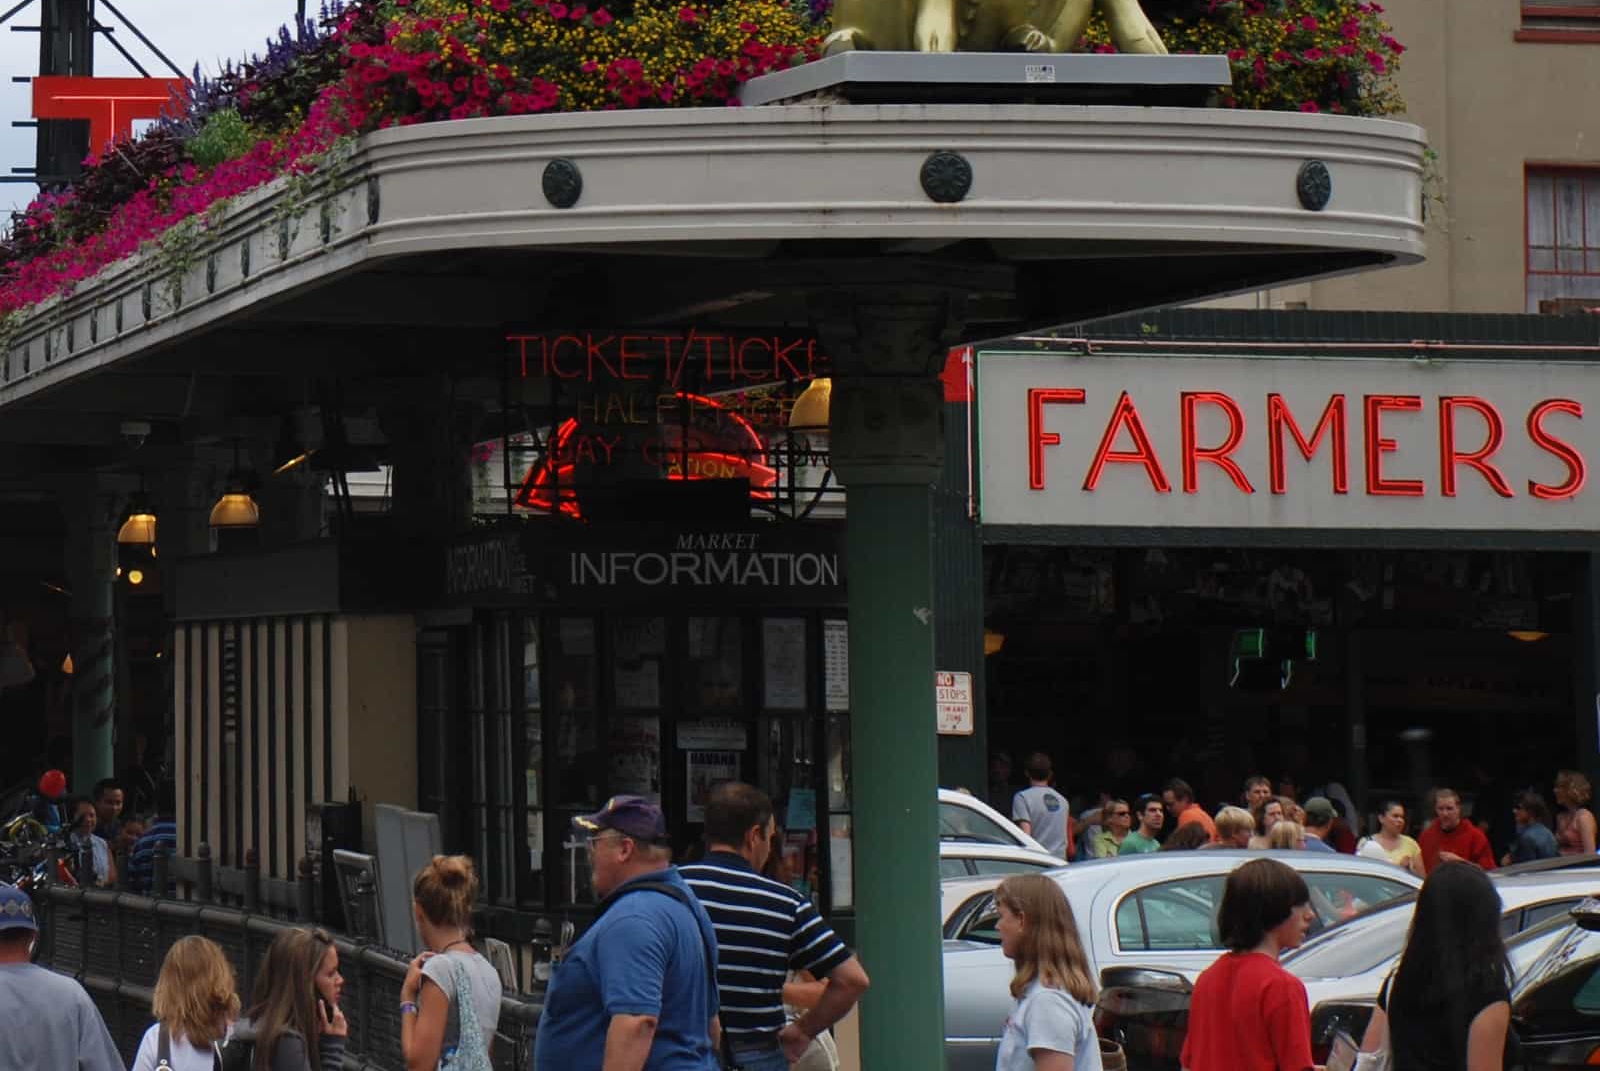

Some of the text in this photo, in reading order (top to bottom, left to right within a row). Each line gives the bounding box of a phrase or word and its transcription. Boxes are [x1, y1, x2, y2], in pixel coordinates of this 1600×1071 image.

[1026, 387, 1588, 502] FARMERS
[676, 532, 760, 550] MARKET
[570, 552, 839, 587] INFORMATION
